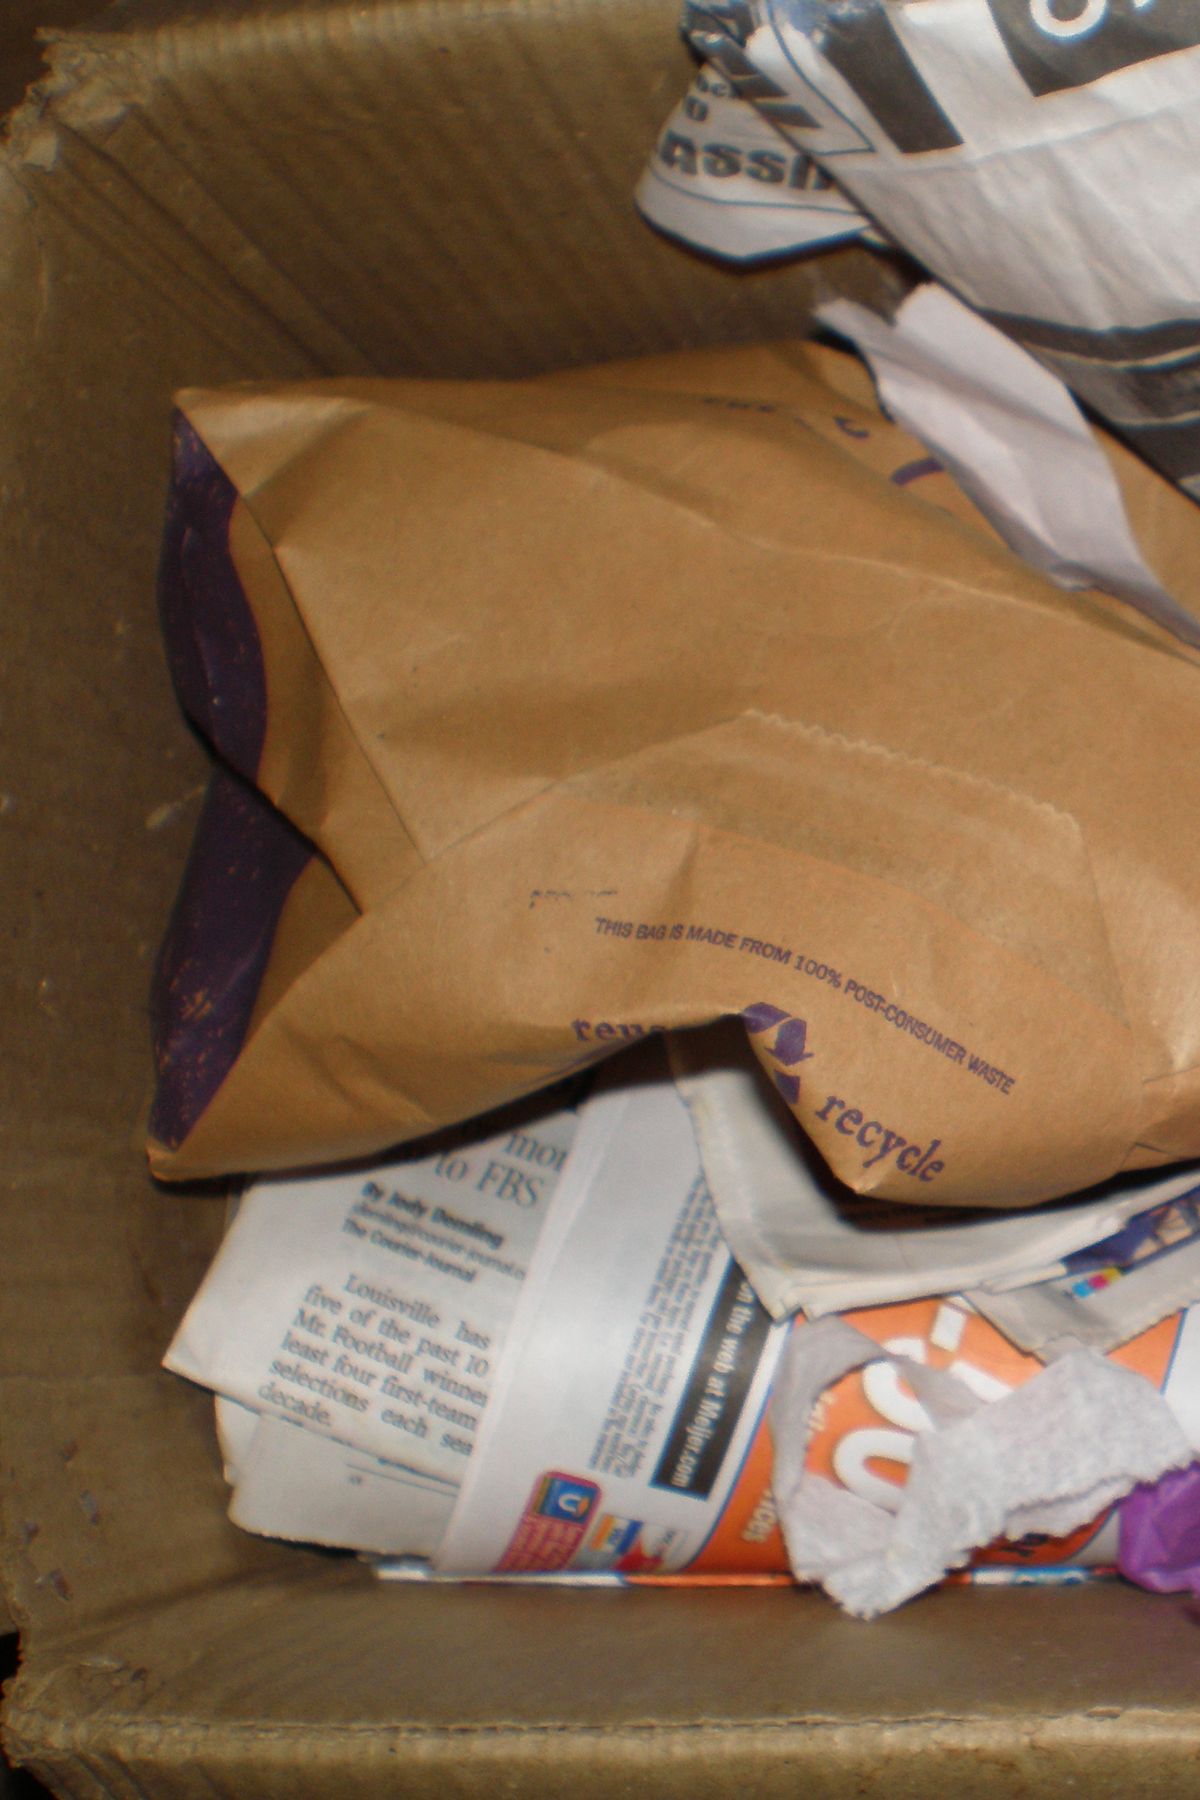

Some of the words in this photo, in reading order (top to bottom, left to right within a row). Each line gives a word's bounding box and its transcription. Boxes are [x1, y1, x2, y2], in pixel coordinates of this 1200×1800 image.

[595, 917, 633, 939] THIS
[636, 923, 667, 941] BAG
[669, 924, 683, 941] IS
[686, 925, 736, 950] MADE
[739, 937, 792, 965] FROM
[793, 954, 843, 988] 100%
[844, 979, 967, 1064] POST-CONSUMER
[967, 1051, 1017, 1095] WASTE
[815, 1092, 945, 1183] recycle
[476, 1155, 543, 1208] FBS
[293, 1308, 327, 1339] Mr.
[331, 1324, 413, 1375] Football
[304, 1284, 342, 1314] five
[349, 1297, 377, 1326] of
[378, 1308, 412, 1344] the
[416, 1323, 459, 1366] past
[464, 1353, 490, 1378] 10
[343, 1273, 441, 1329] Louisville
[454, 1320, 491, 1351] has
[726, 1306, 752, 1335] the
[281, 1331, 328, 1366] least
[331, 1355, 378, 1386] four
[379, 1373, 478, 1431] first-team
[705, 1377, 725, 1397] at
[713, 1339, 739, 1374] web
[257, 1380, 333, 1427] decade.
[268, 1357, 370, 1412] selections
[380, 1405, 430, 1439] each
[671, 1398, 723, 1488] Meijer.com
